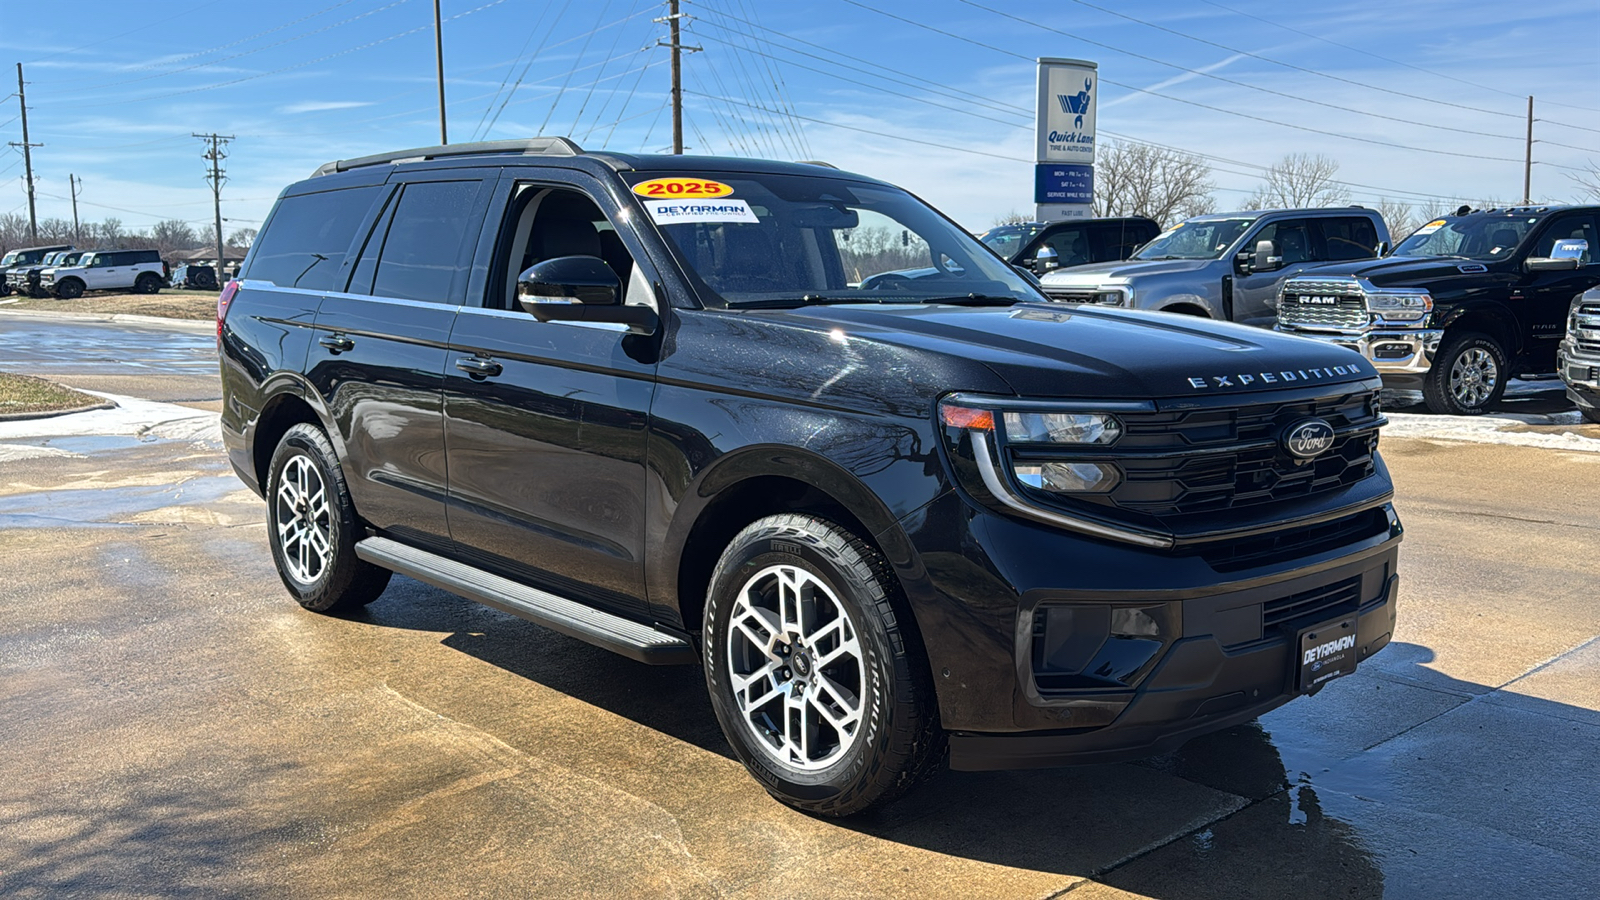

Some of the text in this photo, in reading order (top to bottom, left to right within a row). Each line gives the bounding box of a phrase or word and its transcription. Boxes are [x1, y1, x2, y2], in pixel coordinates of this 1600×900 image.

[1048, 130, 1094, 144] Quick Lane
[647, 182, 721, 195] 2025
[658, 205, 744, 214] DEYARMAN
[1298, 296, 1336, 304] RAM
[1187, 363, 1361, 389] EXPEDITION
[1298, 427, 1326, 451] Ford
[1303, 634, 1356, 666] DEYARMAN
[860, 615, 880, 748] SCORPION
